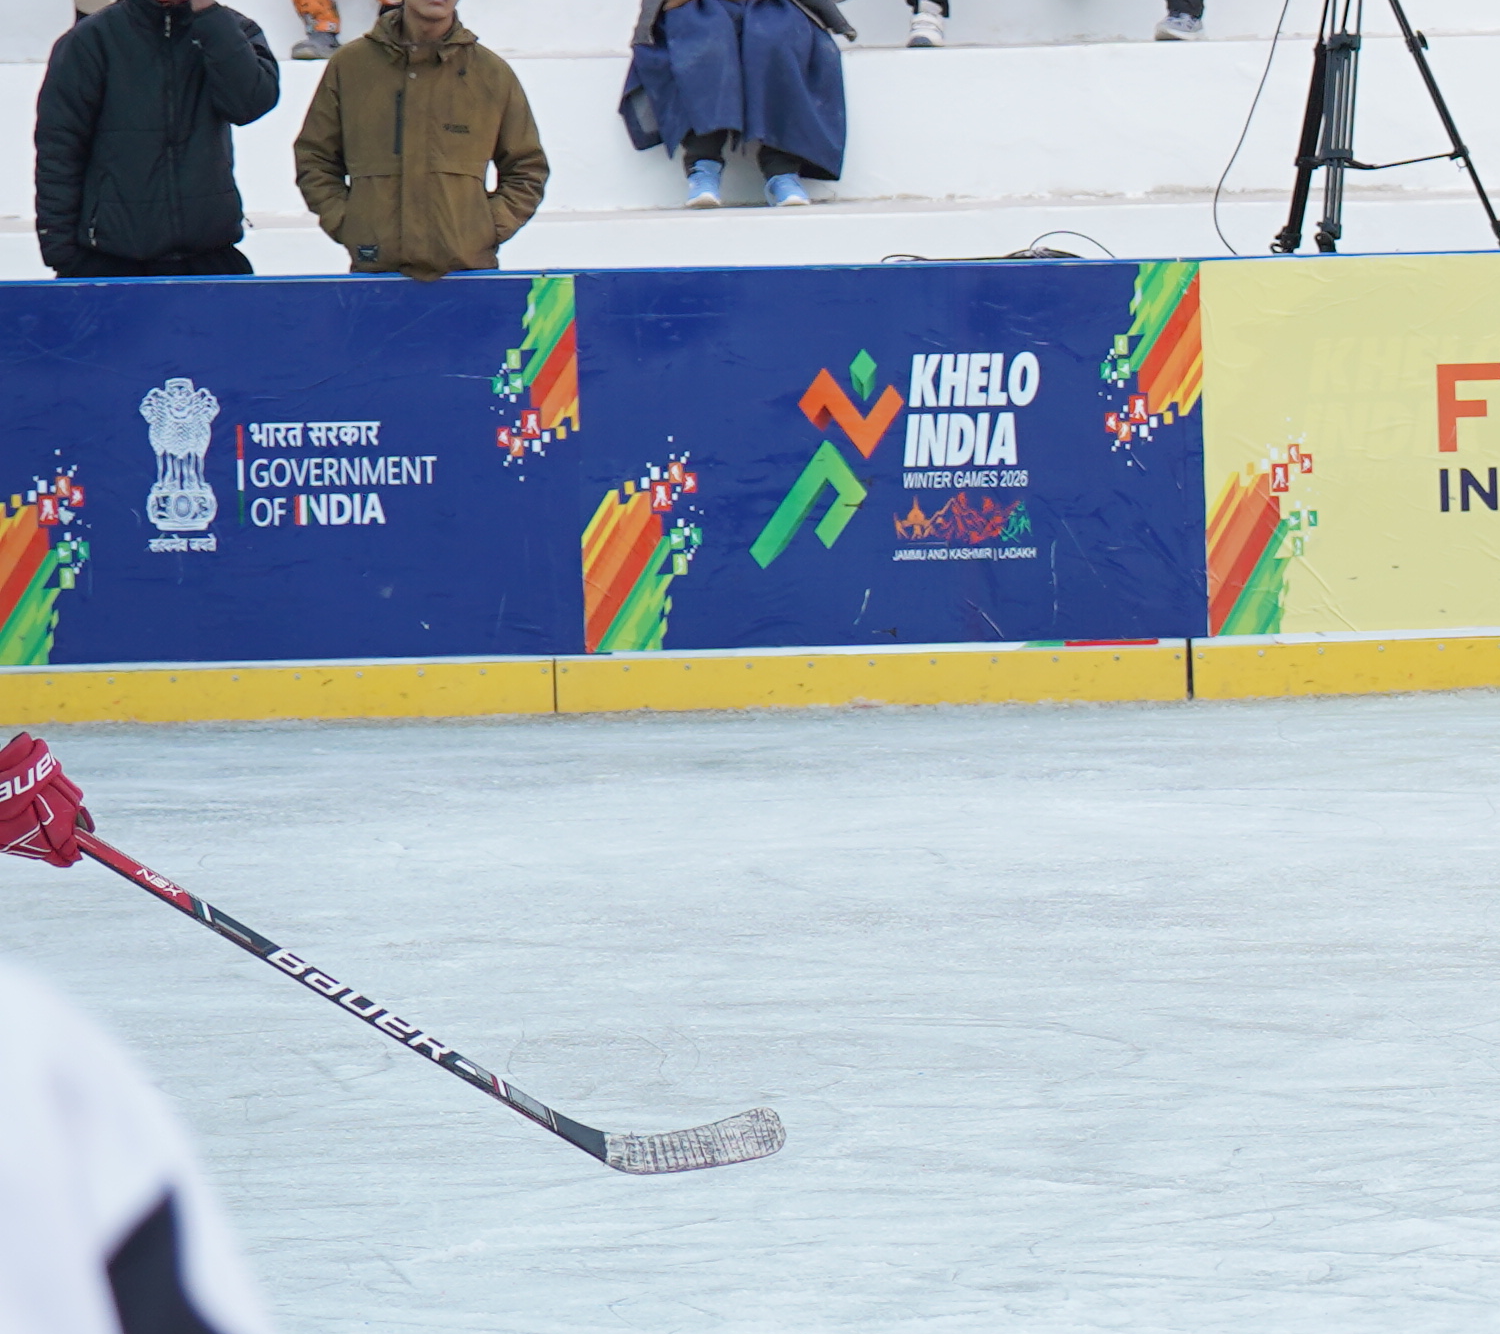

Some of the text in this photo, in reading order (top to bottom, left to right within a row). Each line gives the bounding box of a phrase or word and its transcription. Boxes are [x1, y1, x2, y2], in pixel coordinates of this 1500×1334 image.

[909, 352, 1040, 407] KHELO
[249, 421, 380, 447] भारत सरकार
[903, 412, 1018, 467] INDIA
[250, 455, 437, 487] GOVERNMENT
[903, 470, 1029, 489] WINTER GAMES 2026
[250, 493, 386, 527] OF INDIA
[893, 548, 1037, 561] JAMMU AND KASHMIR LADAKH
